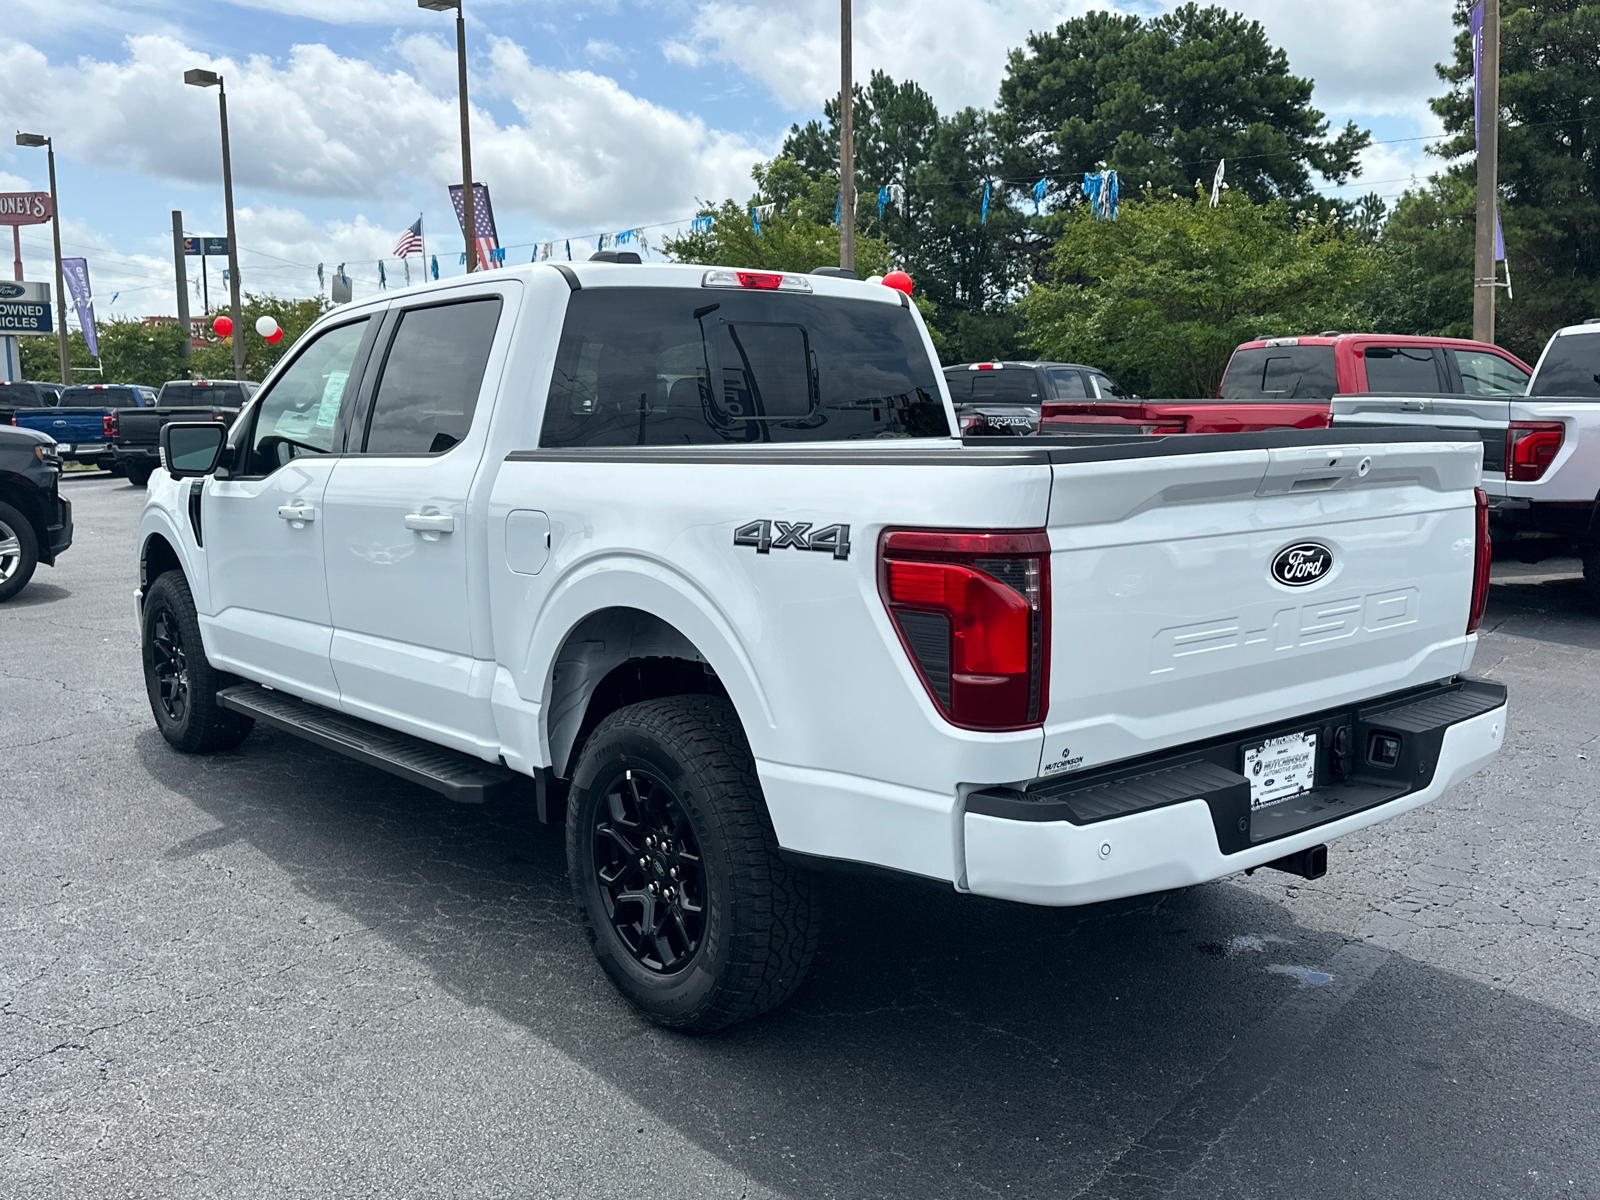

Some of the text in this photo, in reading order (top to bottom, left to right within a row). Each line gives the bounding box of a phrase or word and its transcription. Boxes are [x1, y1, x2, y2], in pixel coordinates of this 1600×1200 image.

[0, 304, 43, 316] OWNED
[0, 316, 38, 328] ICLES
[988, 416, 1032, 430] RAPTOR
[1284, 549, 1323, 580] Ford
[1150, 585, 1421, 675] F-150
[1044, 756, 1083, 771] HUTCHINSON
[1263, 751, 1310, 771] HUTCHINSON
[1263, 766, 1291, 778] AUTOMOTIVE
